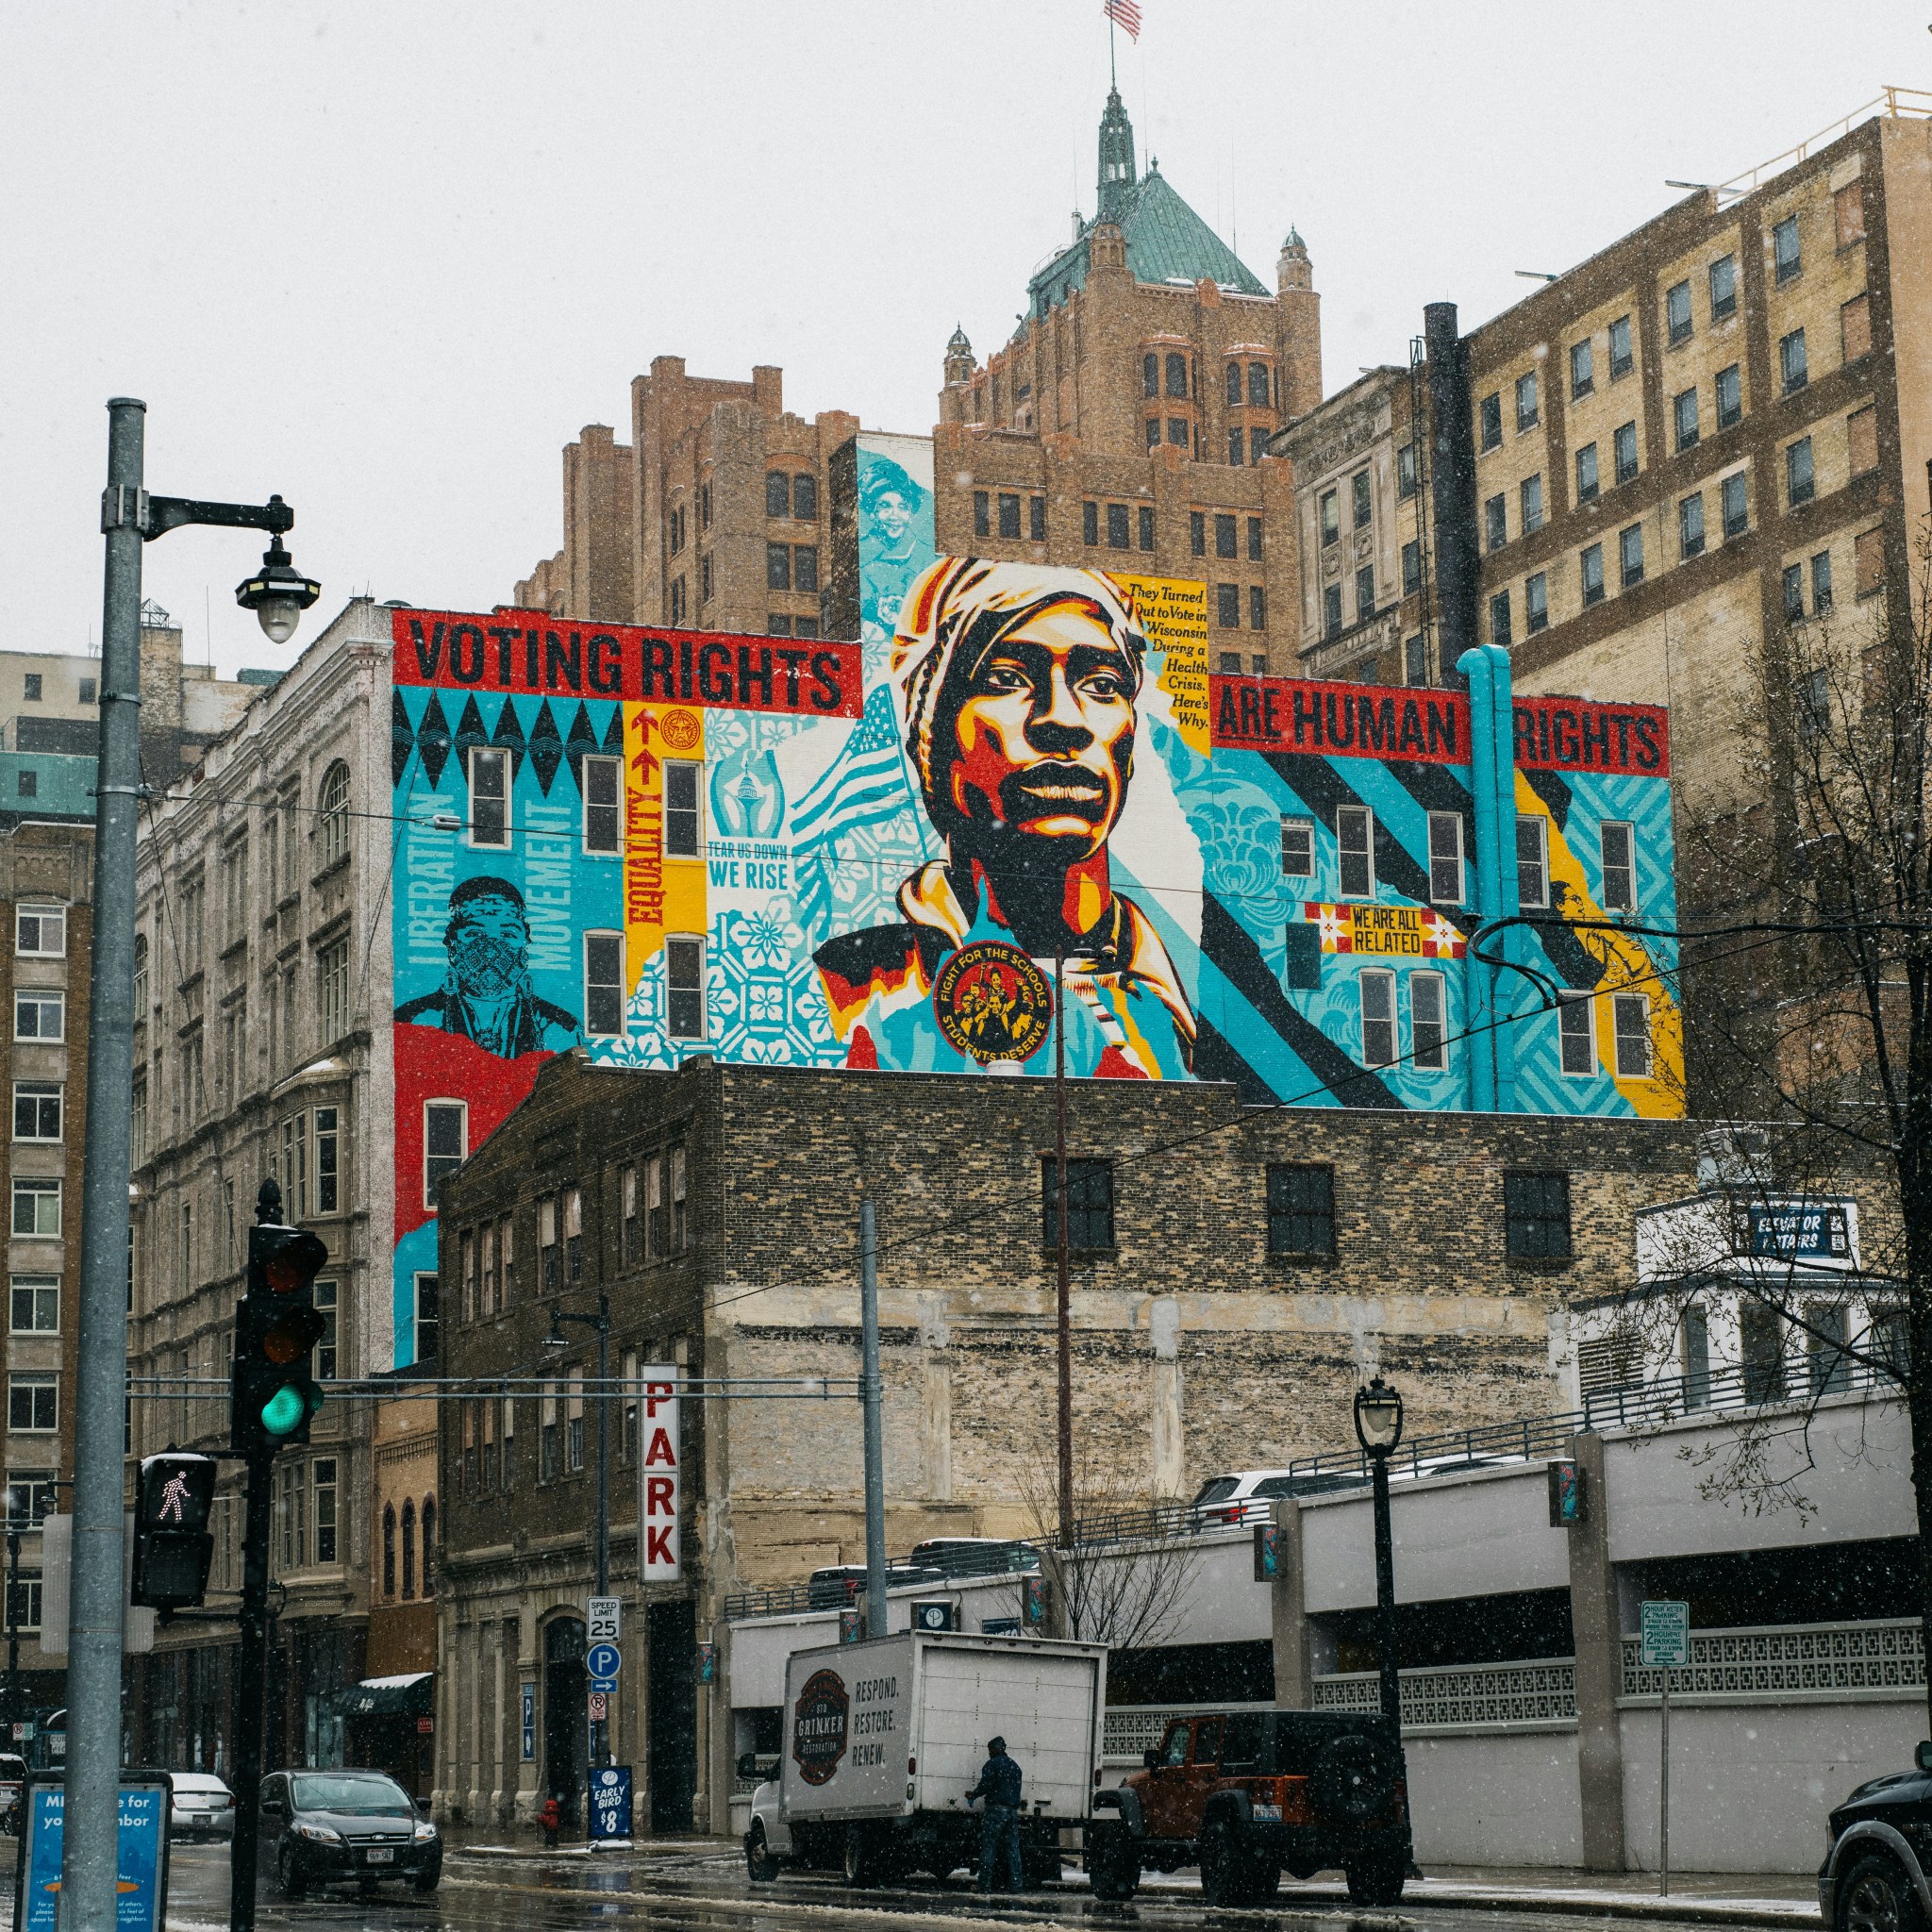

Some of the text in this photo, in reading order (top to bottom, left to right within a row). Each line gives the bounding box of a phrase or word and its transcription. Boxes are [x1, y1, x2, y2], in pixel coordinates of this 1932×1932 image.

[1129, 583, 1205, 604] They Turned
[1158, 607, 1169, 619] to
[1170, 606, 1194, 620] Vote
[1196, 609, 1208, 622] in
[1148, 622, 1208, 640] Wisconsin
[1153, 639, 1206, 658] During a
[409, 619, 843, 710] VOTING RIGHTS
[1167, 658, 1208, 675] Health
[1168, 675, 1207, 691] Crisis.
[1173, 693, 1209, 709] Here's
[1179, 712, 1209, 728] Why.
[1218, 684, 1660, 770] ARE HUMAN RIGHTS
[627, 787, 667, 926] EQUALITY
[708, 841, 788, 860] TEAR US DOWN
[525, 799, 572, 971] MOVEMENT
[708, 860, 788, 890] WE RISE
[1353, 907, 1420, 931] WE ARE ALL
[1355, 931, 1420, 954] RELATED
[941, 947, 1047, 1008] FIGHT FOR THE SCHOOLS
[943, 1015, 1046, 1061] STUDENTS DESERVE
[645, 1381, 676, 1565] PARK
[1645, 1607, 1650, 1618] 2
[591, 1621, 616, 1637] 25
[1646, 1631, 1653, 1644] 2
[598, 1651, 612, 1673] P
[856, 1676, 899, 1703] RESPOND.
[798, 1716, 843, 1737] GRINKER
[854, 1709, 896, 1735] RESTORE.
[803, 1741, 837, 1755] RESTORATION
[852, 1742, 886, 1767] RENEW.
[128, 1795, 149, 1807] for
[594, 1786, 625, 1801] EARLY
[598, 1795, 622, 1809] BIRD
[601, 1810, 617, 1833] $8
